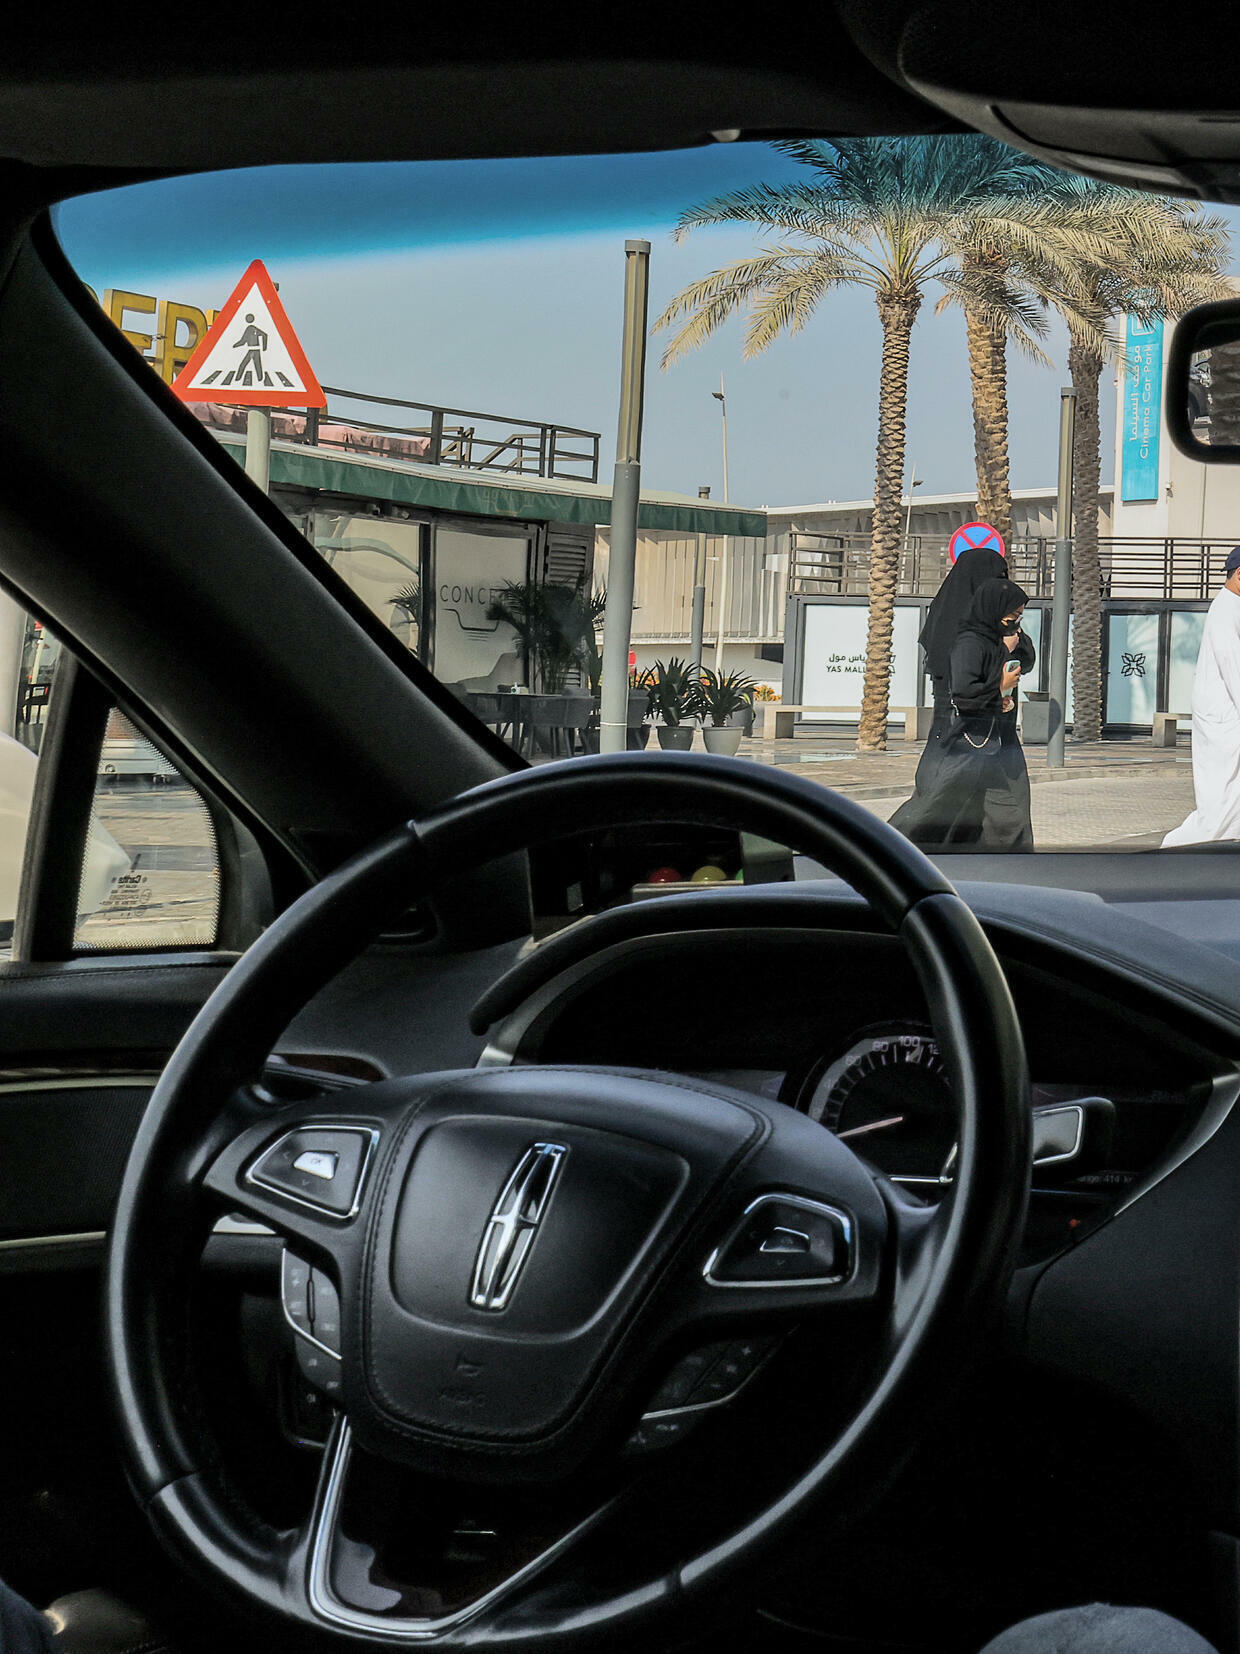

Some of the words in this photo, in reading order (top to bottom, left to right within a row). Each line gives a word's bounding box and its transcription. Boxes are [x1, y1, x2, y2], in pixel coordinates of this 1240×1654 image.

[1143, 344, 1153, 373] Park
[1142, 377, 1152, 403] Car
[1139, 407, 1151, 459] Cinema
[828, 653, 846, 663] مول
[826, 665, 842, 673] YAS
[844, 665, 867, 674] MALL
[899, 1035, 921, 1047] 100
